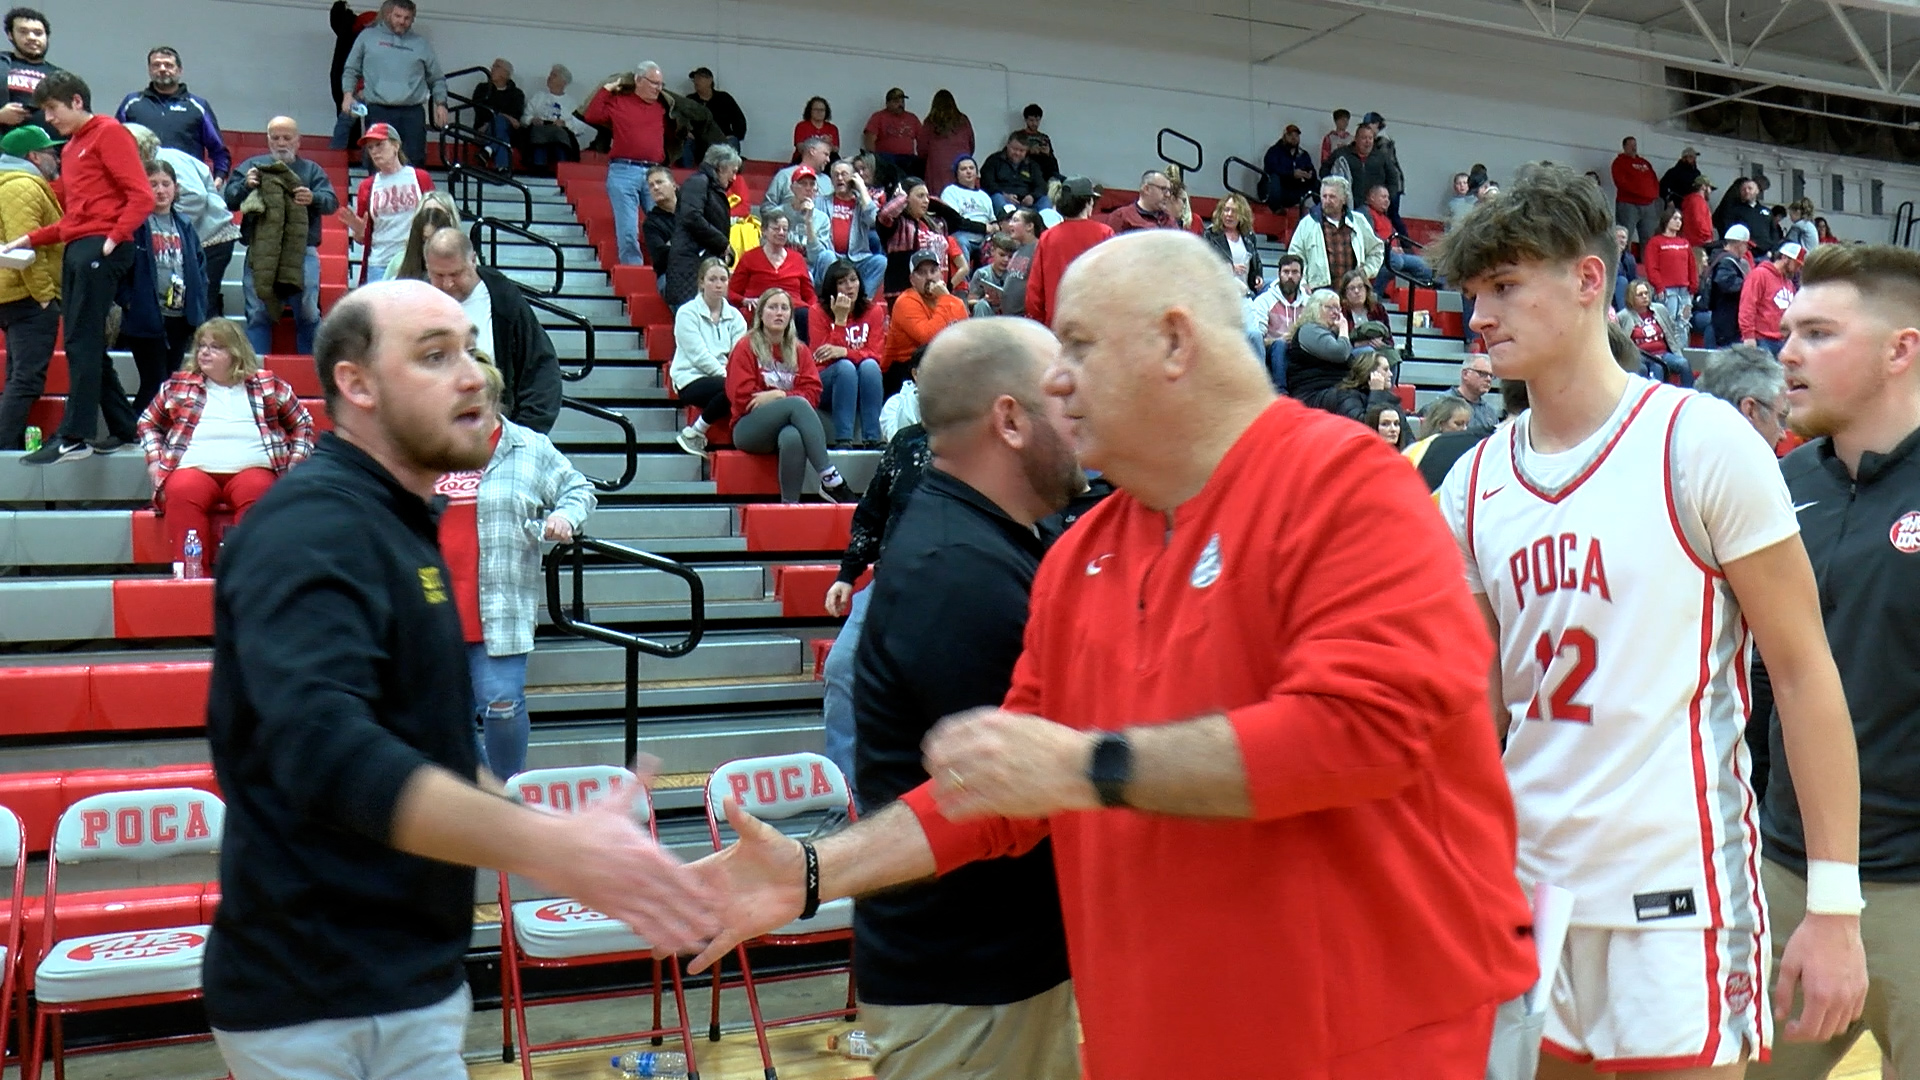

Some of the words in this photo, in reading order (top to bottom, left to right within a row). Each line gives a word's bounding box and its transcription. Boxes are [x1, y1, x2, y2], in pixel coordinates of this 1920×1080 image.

[1508, 532, 1612, 613] POCA
[1525, 625, 1598, 725] 12
[726, 761, 833, 806] POCA
[80, 800, 211, 849] POCA
[1674, 896, 1688, 911] M
